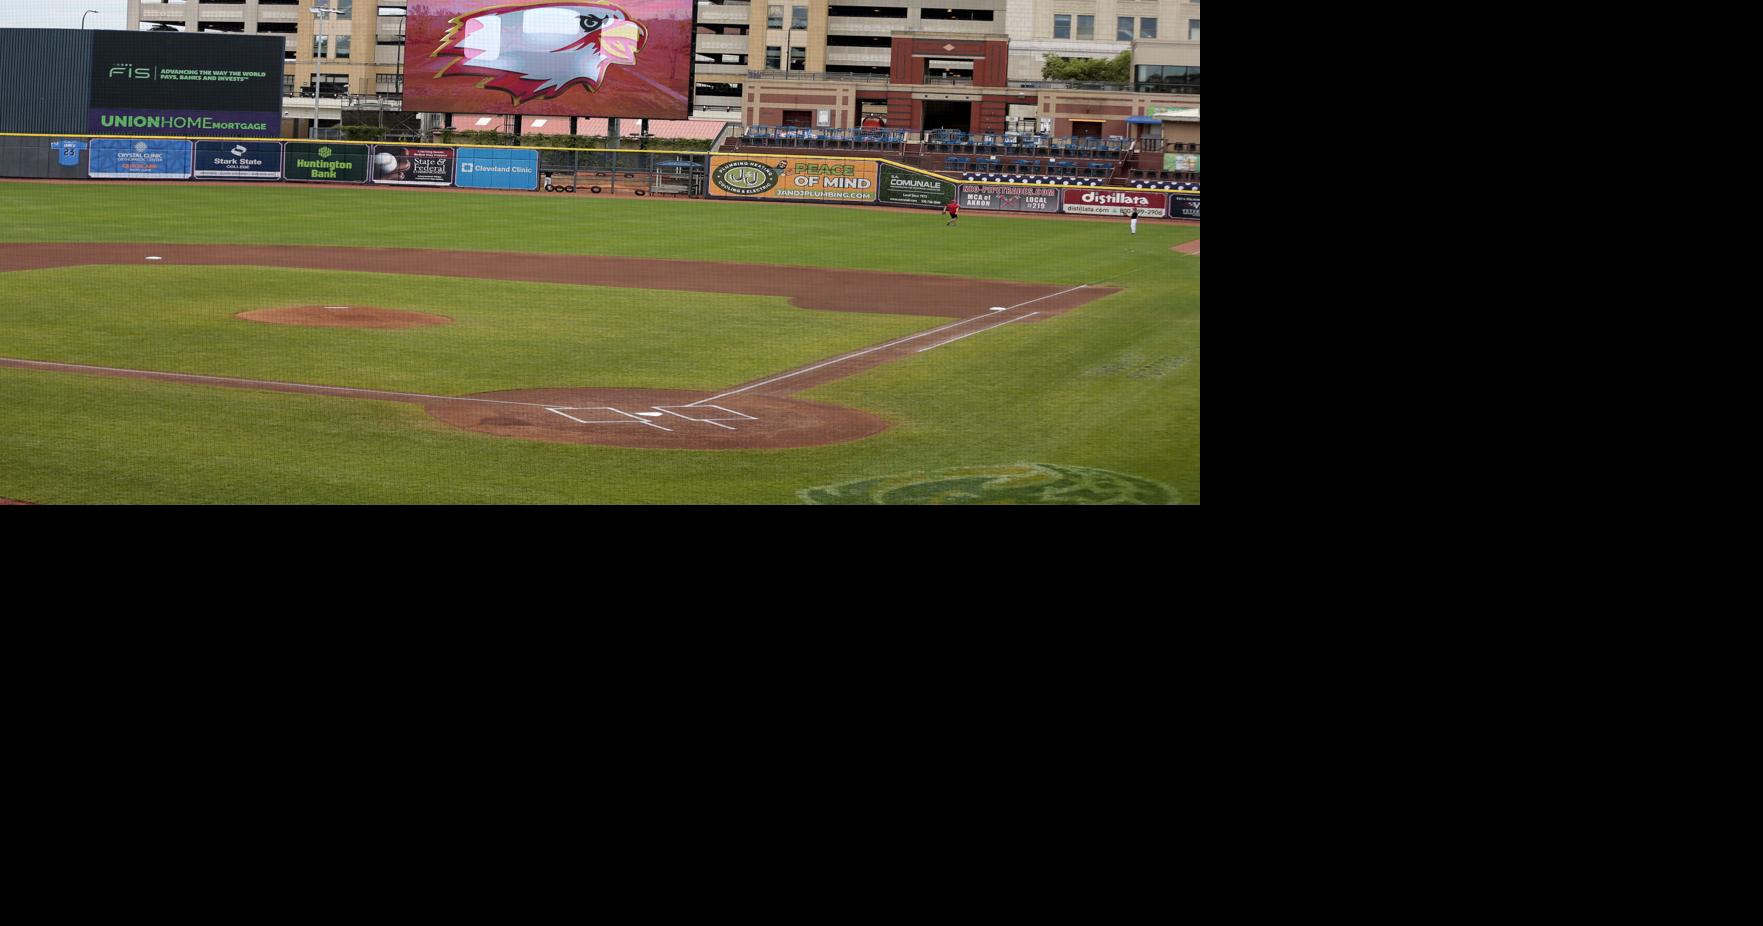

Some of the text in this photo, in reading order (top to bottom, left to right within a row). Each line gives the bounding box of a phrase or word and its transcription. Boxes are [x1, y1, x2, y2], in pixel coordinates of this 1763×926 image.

[297, 159, 353, 171] Huntington
[414, 157, 447, 166] State &
[311, 170, 337, 178] Bank
[413, 164, 446, 173] Federal
[512, 166, 533, 174] Clinic
[718, 161, 773, 176] PLUMBING HEATING
[795, 163, 855, 176] PEACE
[718, 181, 741, 193] COOLING
[746, 182, 772, 194] ELECTRIC
[794, 176, 872, 189] OF MIND
[890, 178, 941, 189] COMUNALE
[777, 189, 870, 199] JANDJPLUMBING.COM
[1081, 191, 1149, 205] distillata
[1025, 196, 1048, 204] LOCAL
